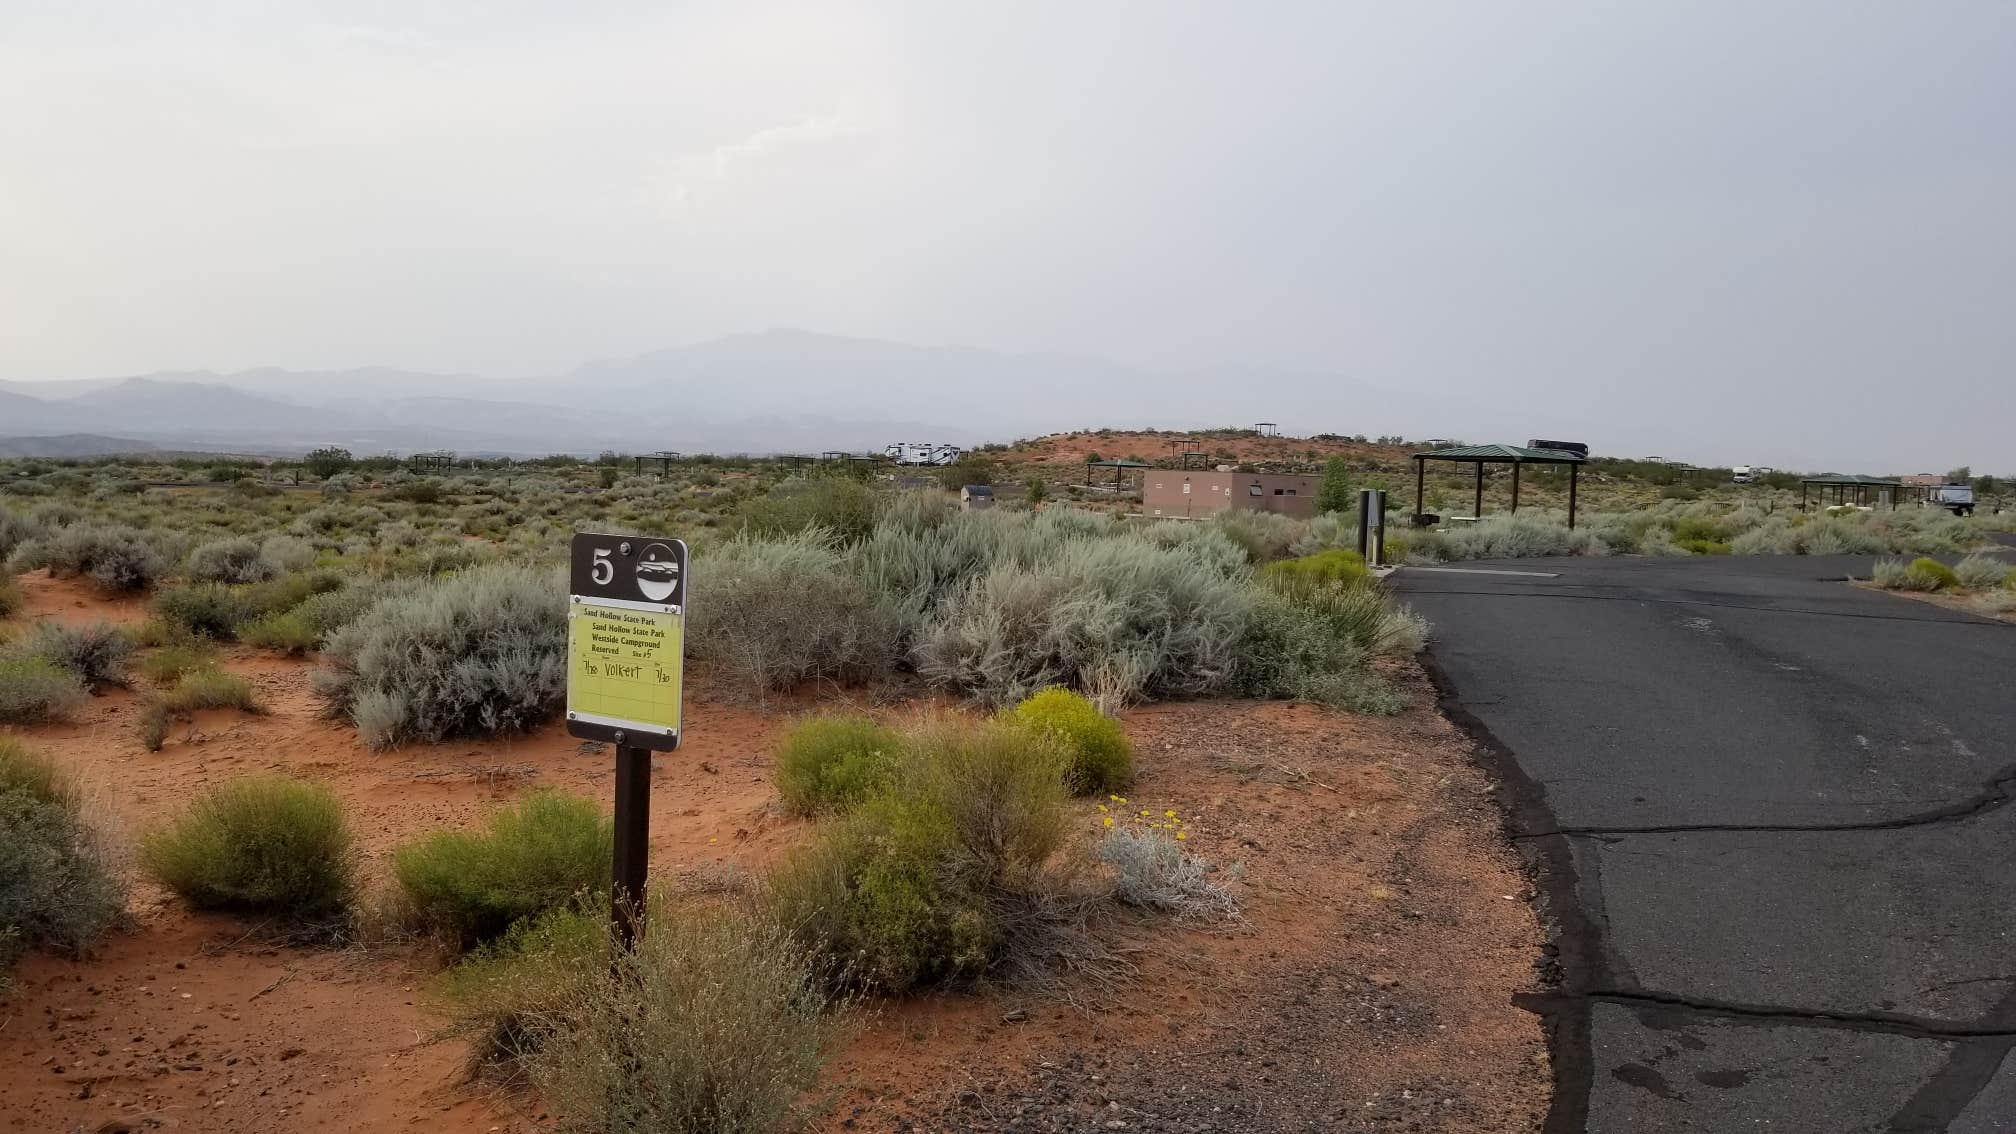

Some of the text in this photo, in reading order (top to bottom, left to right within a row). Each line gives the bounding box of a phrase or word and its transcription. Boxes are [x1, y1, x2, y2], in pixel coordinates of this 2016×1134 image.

[592, 548, 614, 585] 5
[584, 608, 656, 626] Sand Hollow State Park
[592, 622, 665, 638] Sand Hollow State Park
[592, 633, 661, 649] Westside Campground
[591, 644, 619, 655] Reserved
